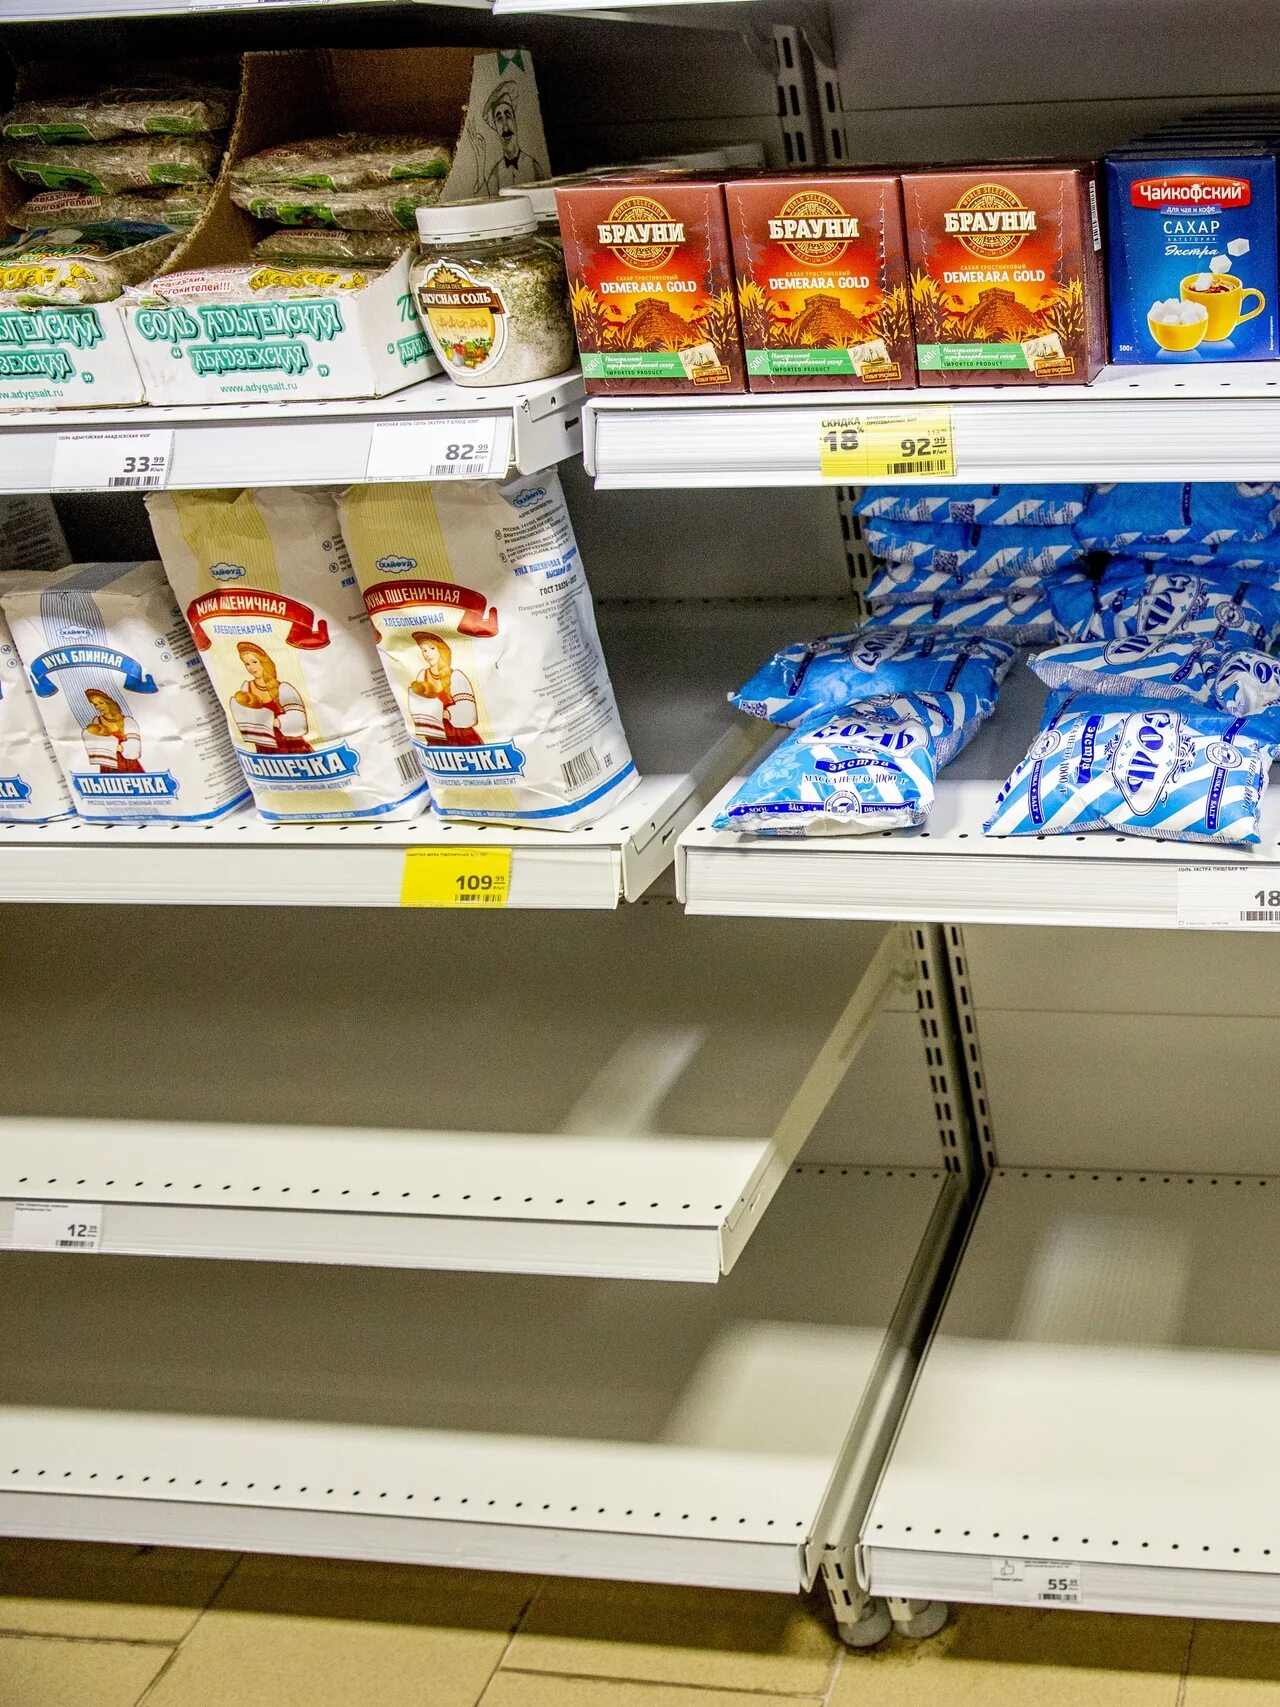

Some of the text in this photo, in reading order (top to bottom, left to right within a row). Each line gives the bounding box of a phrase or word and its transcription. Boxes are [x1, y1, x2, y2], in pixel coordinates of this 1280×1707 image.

[963, 187, 1016, 206] WORLD SELECTION
[1140, 181, 1242, 202] Чайкофский
[614, 199, 665, 218] WORLD SELECTION
[786, 194, 838, 213] WORLD SELECTION
[768, 219, 859, 239] БРАУНИ
[944, 212, 1036, 232] БРАУНИ
[1164, 221, 1219, 234] САХАР
[597, 223, 685, 243] БРАУНИ
[1165, 245, 1219, 258] Экстра
[769, 277, 869, 290] DEMERARA GOLD
[943, 270, 1045, 283] DEMERARA GOLD
[601, 281, 696, 294] DEMERARA GOLD
[461, 292, 492, 304] СОЛЬ
[138, 304, 343, 343] СОЛЬ АДЫГЕЙСКАЯ
[190, 344, 309, 375] АБАДЗЕХСКАЯ
[220, 382, 298, 394] www.adygsalt.ru
[821, 416, 861, 428] СКИДКА
[823, 429, 859, 452] 18
[901, 437, 946, 457] 92 99
[445, 443, 475, 461] 82
[123, 456, 150, 473] 33
[195, 595, 287, 617] МУКА ПШЕНИЧНАЯ
[384, 589, 460, 606] ПШЕНИЧНАЯ
[384, 613, 445, 628] ХЛЕБОПЕКАРНАЯ
[213, 624, 273, 636] ХЛЕБОПЕКАРНАЯ
[42, 650, 124, 669] МУКА БЛИННАЯ
[828, 757, 890, 772] экстра
[79, 776, 169, 795] ПЫШЕЧКА
[493, 777, 517, 785] АППЕТИТ
[1208, 769, 1225, 820] DRUSKA SALT
[1031, 793, 1040, 814] SALT
[456, 875, 493, 890] 109
[67, 1224, 87, 1237] 12
[1048, 1578, 1068, 1591] 55
